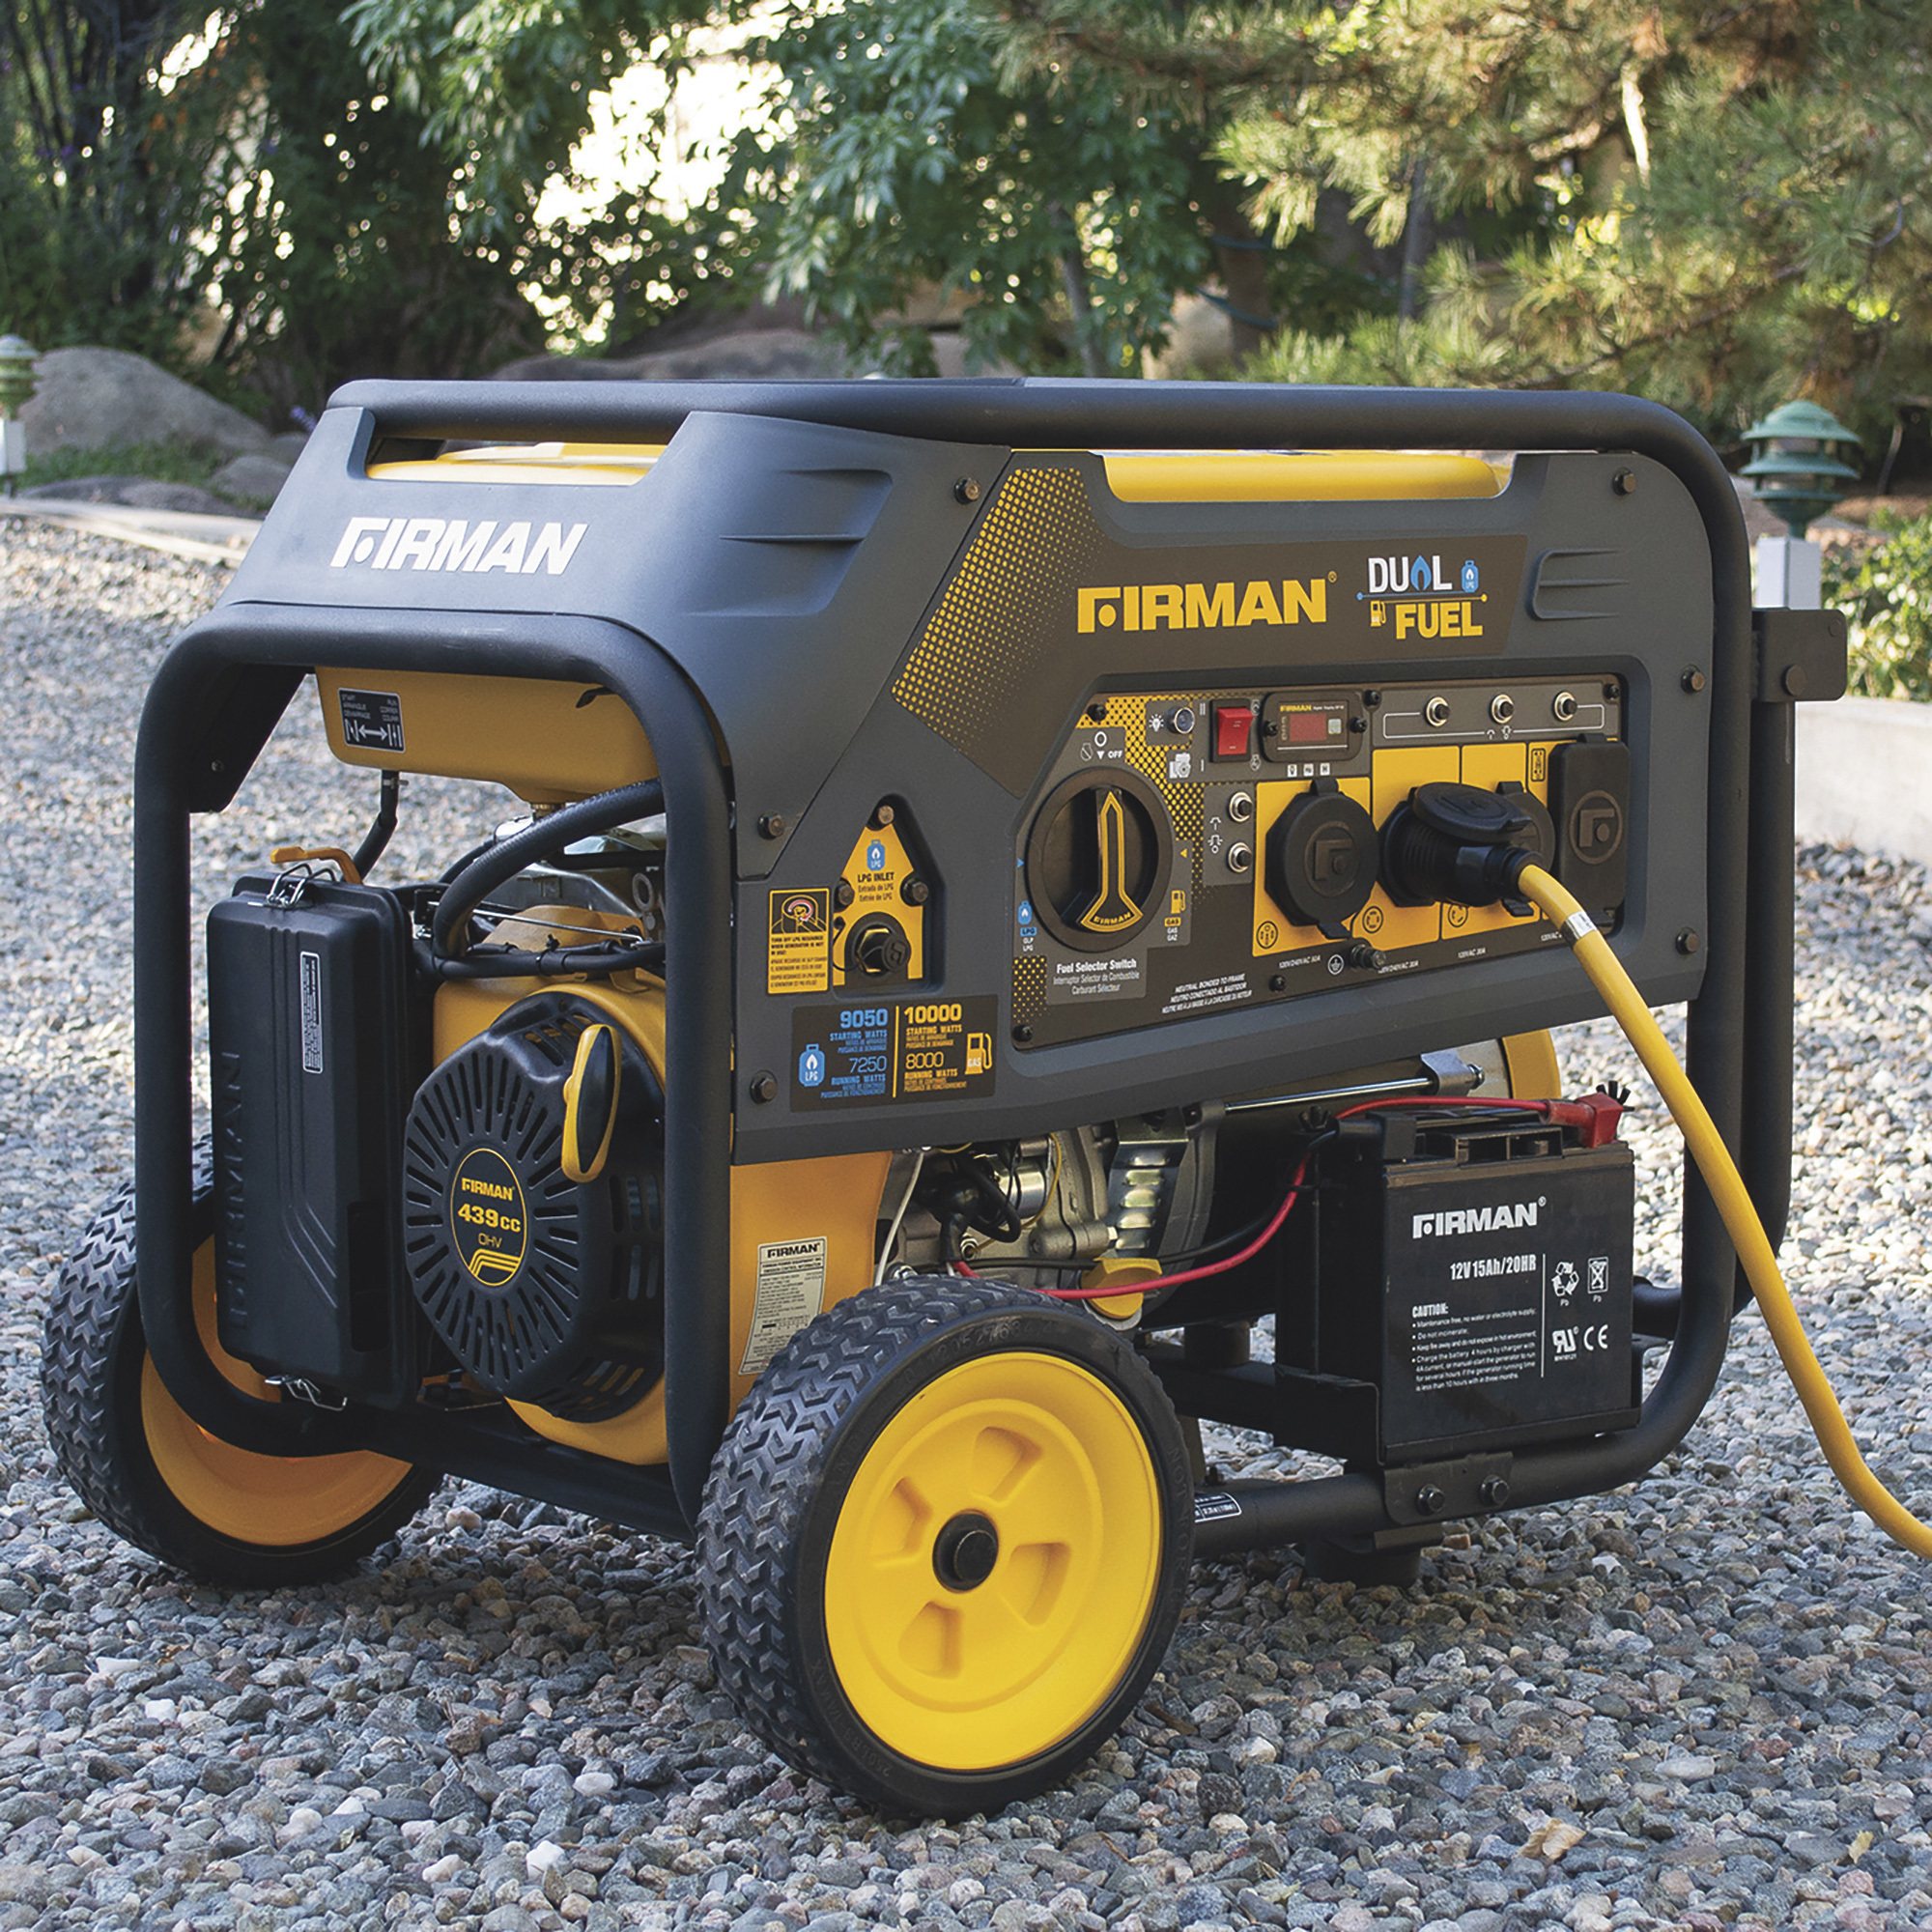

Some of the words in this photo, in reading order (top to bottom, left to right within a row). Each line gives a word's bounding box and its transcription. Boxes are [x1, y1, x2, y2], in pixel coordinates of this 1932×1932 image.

[329, 517, 588, 575] FIRMAN
[1368, 554, 1452, 593] DUAL
[1077, 579, 1327, 634] FIRMAN
[1395, 601, 1483, 639] FUEL
[1107, 751, 1122, 759] OFF
[857, 873, 872, 883] LPG
[873, 871, 895, 881] INLET
[1093, 912, 1131, 925] FIRMAN
[1056, 963, 1074, 974] Fuel
[1075, 960, 1108, 973] Selector
[1109, 958, 1137, 970] Switch
[839, 1008, 889, 1029] 9050
[904, 1004, 962, 1024] 10000
[830, 1030, 862, 1041] STARTING
[865, 1029, 888, 1038] WATTS
[906, 1026, 937, 1036] STARTING
[940, 1024, 962, 1034] WATTS
[849, 1055, 887, 1073] 7250
[905, 1051, 944, 1069] 8000
[968, 1058, 981, 1067] GAS
[805, 1070, 818, 1082] LPG
[863, 1073, 886, 1083] WATTS
[935, 1067, 958, 1077] WATTS
[461, 1178, 513, 1202] FIRMAN
[1412, 1202, 1538, 1238] FIRMAN
[477, 1233, 502, 1248] OHV
[767, 1243, 818, 1259] FIRMAN
[1450, 1261, 1471, 1280] 12V
[1472, 1254, 1537, 1278] 15Ah/20HR
[1412, 1302, 1449, 1318] CAUTION:
[1583, 1324, 1608, 1351] CE
